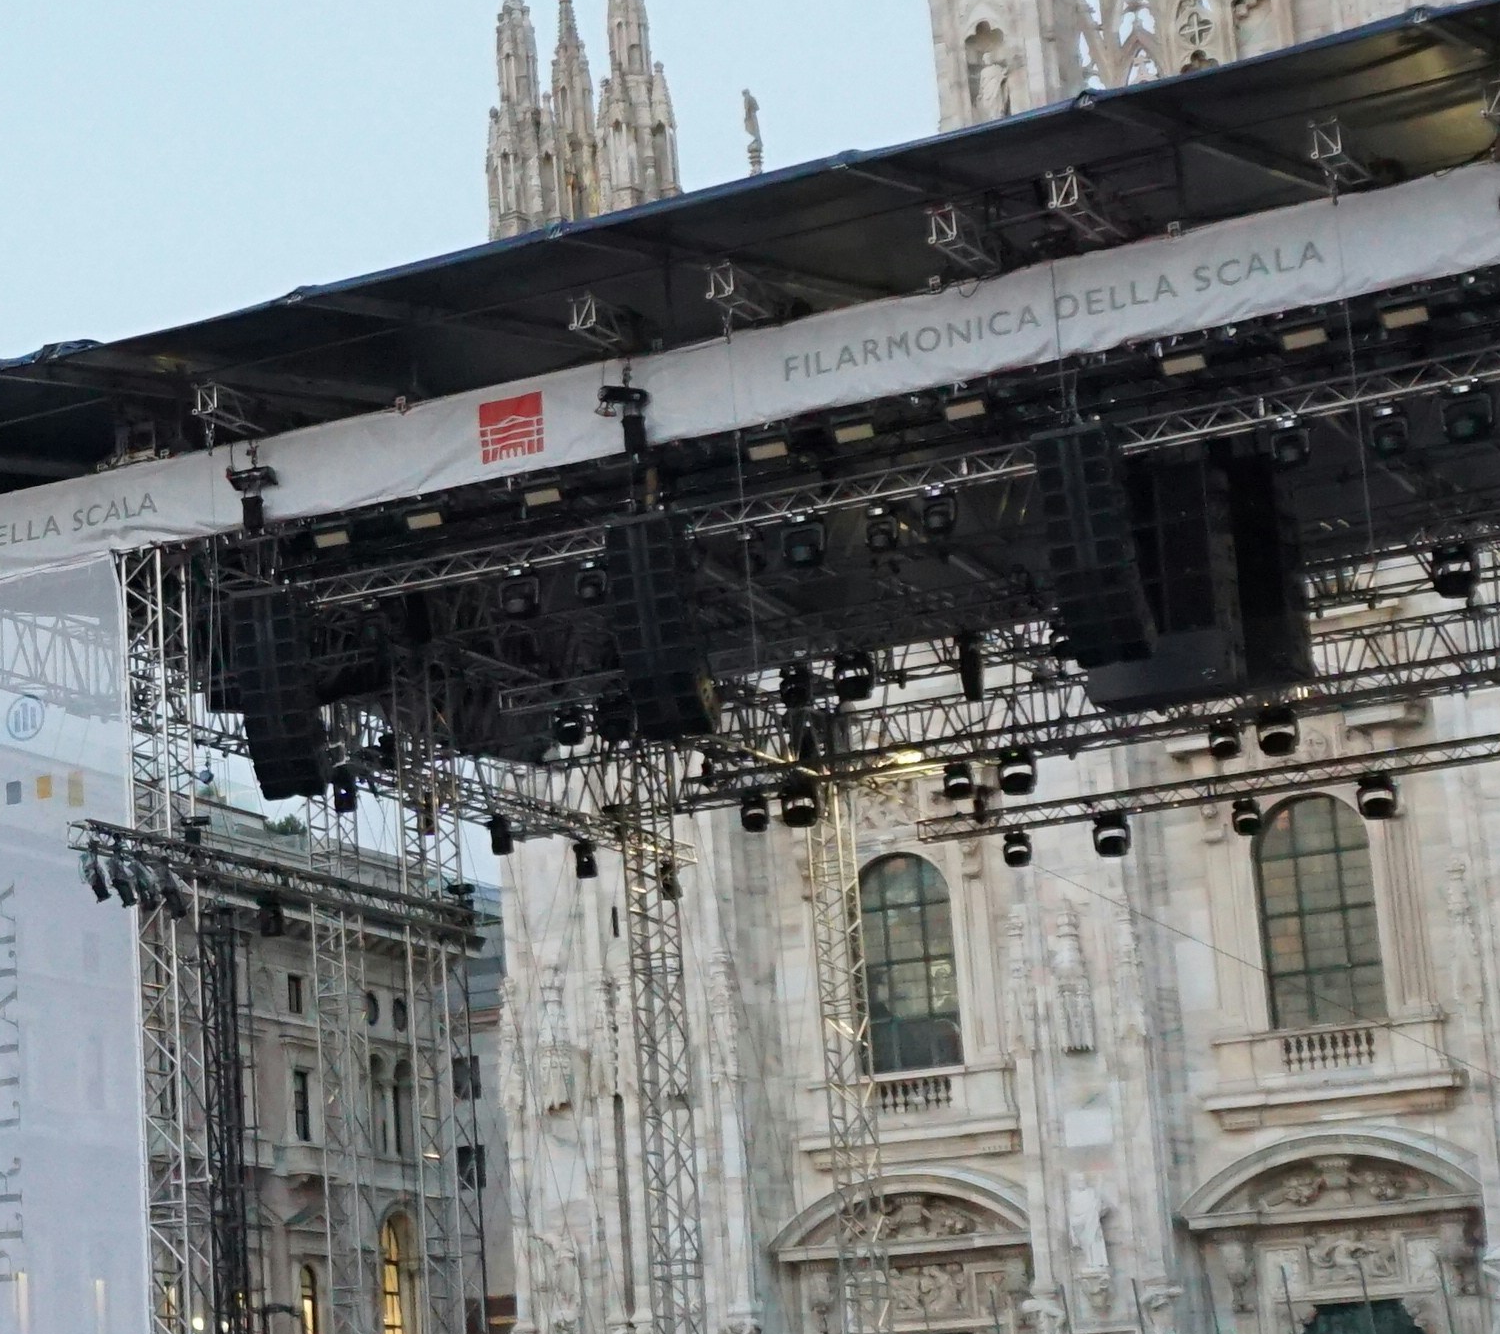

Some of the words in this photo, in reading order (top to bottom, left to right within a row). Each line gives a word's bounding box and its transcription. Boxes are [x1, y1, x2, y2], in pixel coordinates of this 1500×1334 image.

[784, 304, 1042, 381] FILARMONICA
[1054, 274, 1179, 320] DELLA
[1193, 241, 1325, 292] SCALA
[72, 492, 158, 532] SCALA
